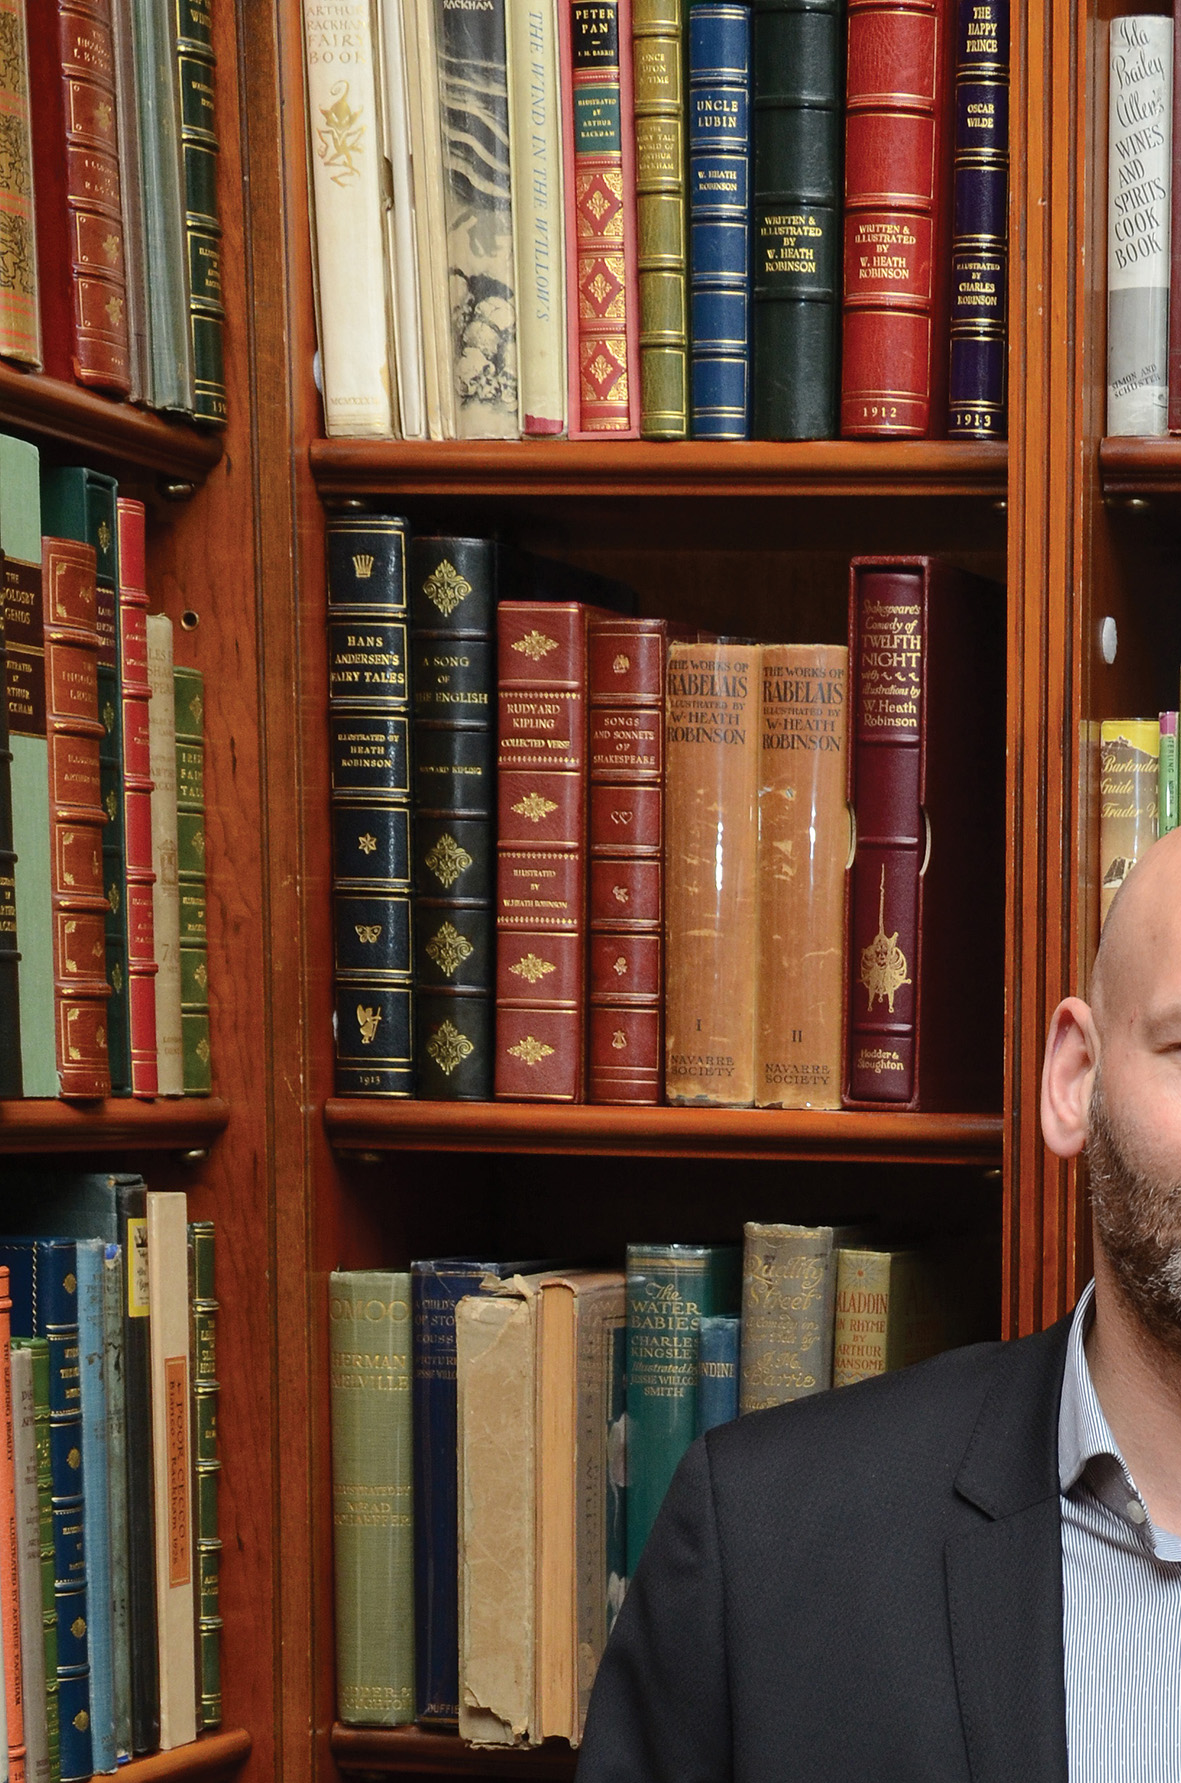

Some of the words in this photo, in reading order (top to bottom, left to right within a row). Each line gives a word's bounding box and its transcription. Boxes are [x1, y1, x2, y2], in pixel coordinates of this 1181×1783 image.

[576, 9, 614, 19] PETER
[530, 11, 542, 53] THE
[582, 23, 608, 34] PAN
[968, 23, 997, 36] HAPPY
[966, 39, 998, 53] PRINCE
[532, 62, 545, 126] WIND
[697, 100, 738, 112] UNCLE
[967, 104, 994, 114] OSCAR
[698, 116, 737, 128] LUBIN
[967, 118, 994, 128] WILDE
[533, 136, 547, 157] IN
[1115, 124, 1165, 160] WINES
[1118, 159, 1145, 188] AND
[533, 171, 547, 210] THE
[1114, 177, 1166, 217] SPIRITS
[765, 216, 806, 226] WRITTEN
[809, 216, 816, 225] &
[1114, 206, 1160, 242] COOK
[760, 227, 822, 237] ILLUSTRATED
[783, 238, 796, 247] BY
[876, 244, 889, 253] BY
[1115, 232, 1163, 270] BOOK
[534, 218, 551, 322] WILLOWS
[765, 261, 816, 273] ROBINSON
[859, 268, 909, 279] ROBINSON
[957, 295, 997, 306] ROBINSON
[1114, 373, 1161, 399] SCHUSTER
[863, 408, 897, 418] 1912
[865, 616, 903, 634] Comedy
[905, 619, 918, 634] of
[347, 636, 384, 647] HANS
[862, 634, 921, 650] TWELFTH
[335, 654, 400, 666] ANDERSEN'S
[862, 652, 921, 667] NIGHT
[331, 672, 360, 683] FAIRY
[364, 672, 404, 683] TALES
[669, 673, 747, 698] RABELAIS
[762, 680, 843, 704] RABELAIS
[507, 704, 561, 715] RUDYARD
[512, 718, 555, 729] KIPLING
[604, 717, 640, 726] SONGS
[864, 712, 917, 727] Robinson
[593, 755, 655, 765] SHAKESPEARE
[1101, 779, 1134, 795] Guide
[671, 1055, 735, 1066] NAVARRE
[858, 1059, 904, 1073] Stoughton
[671, 1066, 735, 1077] SOCIETY
[765, 1064, 830, 1075] NAVARRE
[765, 1075, 830, 1085] SOCIETY
[646, 1282, 682, 1300] The
[631, 1301, 702, 1315] WATER
[836, 1292, 888, 1315] ALADDIN
[330, 1300, 410, 1321] OMOO
[631, 1316, 699, 1331] BABIES
[836, 1344, 882, 1357] ARTHUR
[330, 1353, 407, 1369] HERMAN
[835, 1359, 885, 1371] RANSOME
[330, 1375, 410, 1390] MELVILLE
[643, 1386, 684, 1398] SMITH
